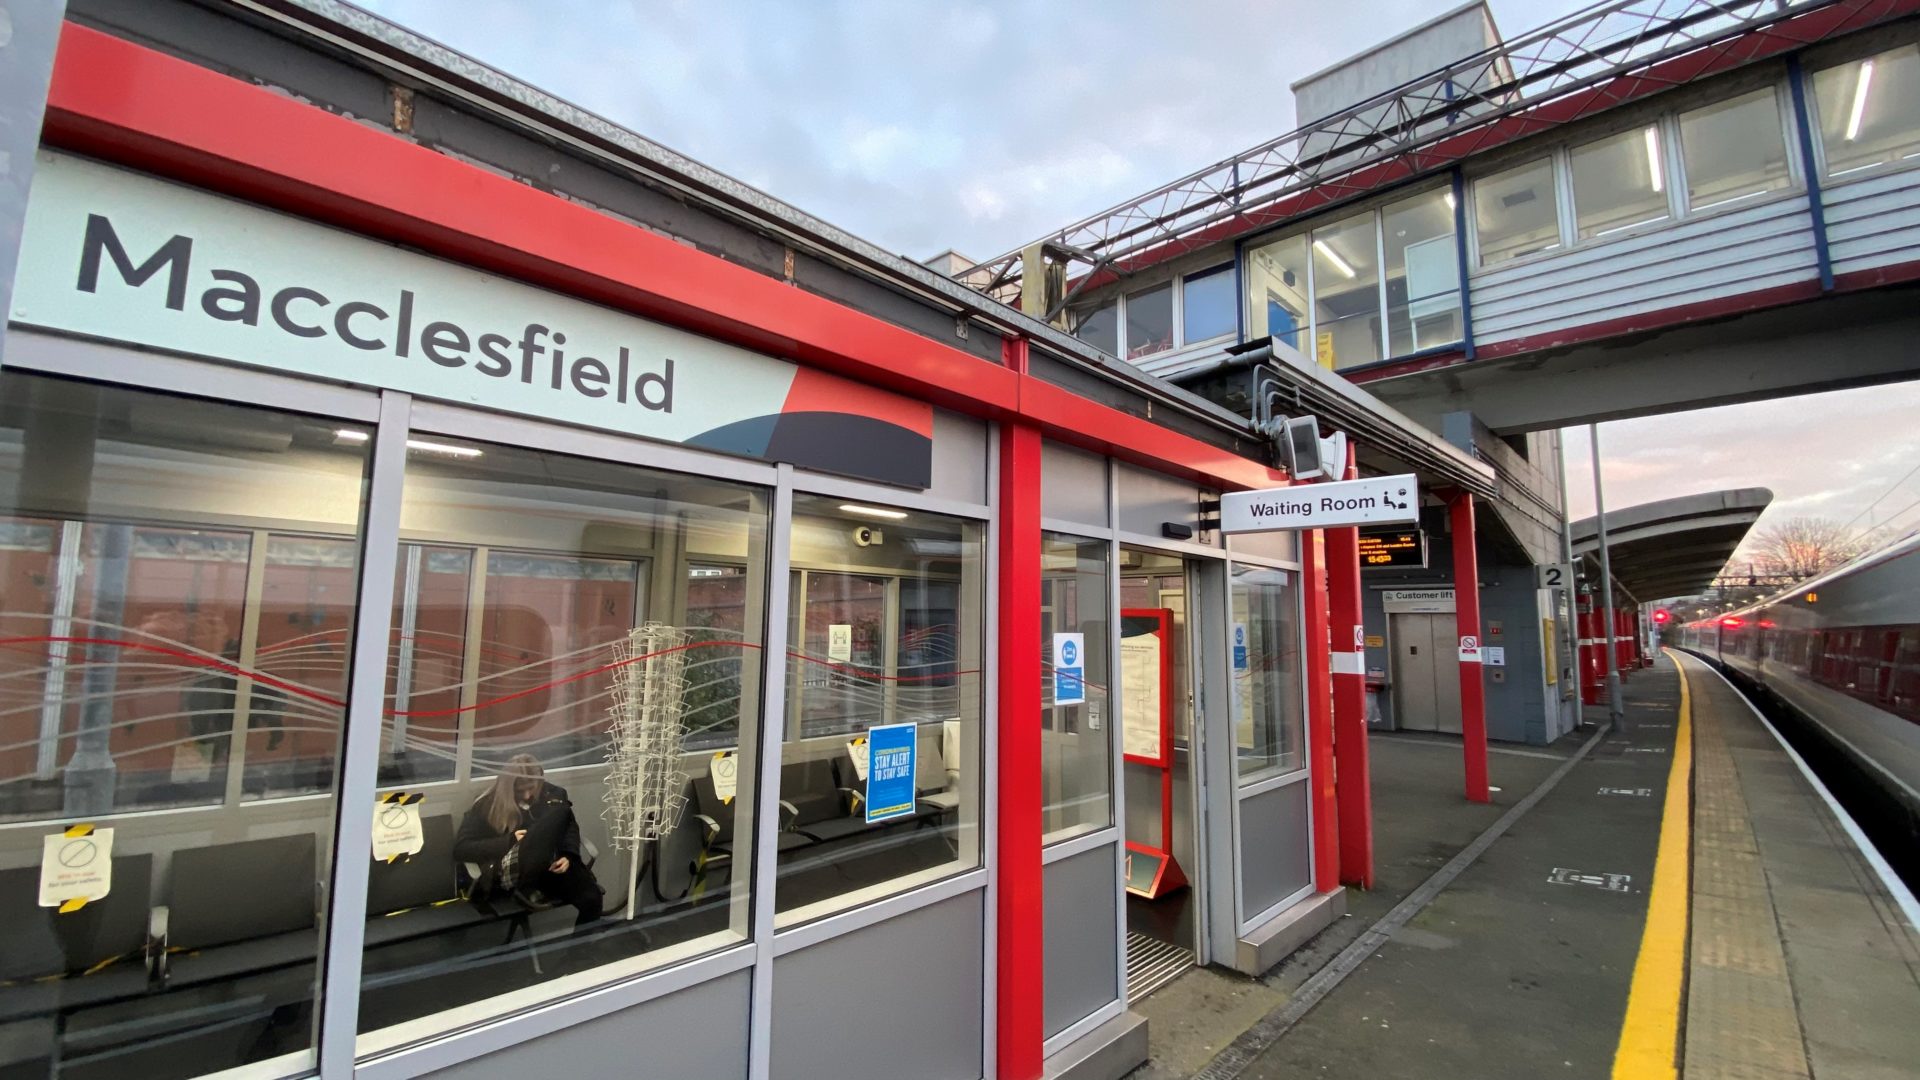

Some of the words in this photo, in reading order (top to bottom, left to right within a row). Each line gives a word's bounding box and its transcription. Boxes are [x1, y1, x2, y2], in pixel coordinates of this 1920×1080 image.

[76, 212, 675, 414] Macclesfield
[1250, 501, 1312, 517] Waiting
[1320, 496, 1376, 512] Room
[1546, 568, 1562, 586] 2
[1440, 591, 1454, 599] lift
[875, 754, 891, 770] STAY
[891, 751, 910, 767] ALERT
[875, 769, 882, 782] TO
[882, 767, 896, 781] STAY
[896, 764, 910, 778] SAFE
